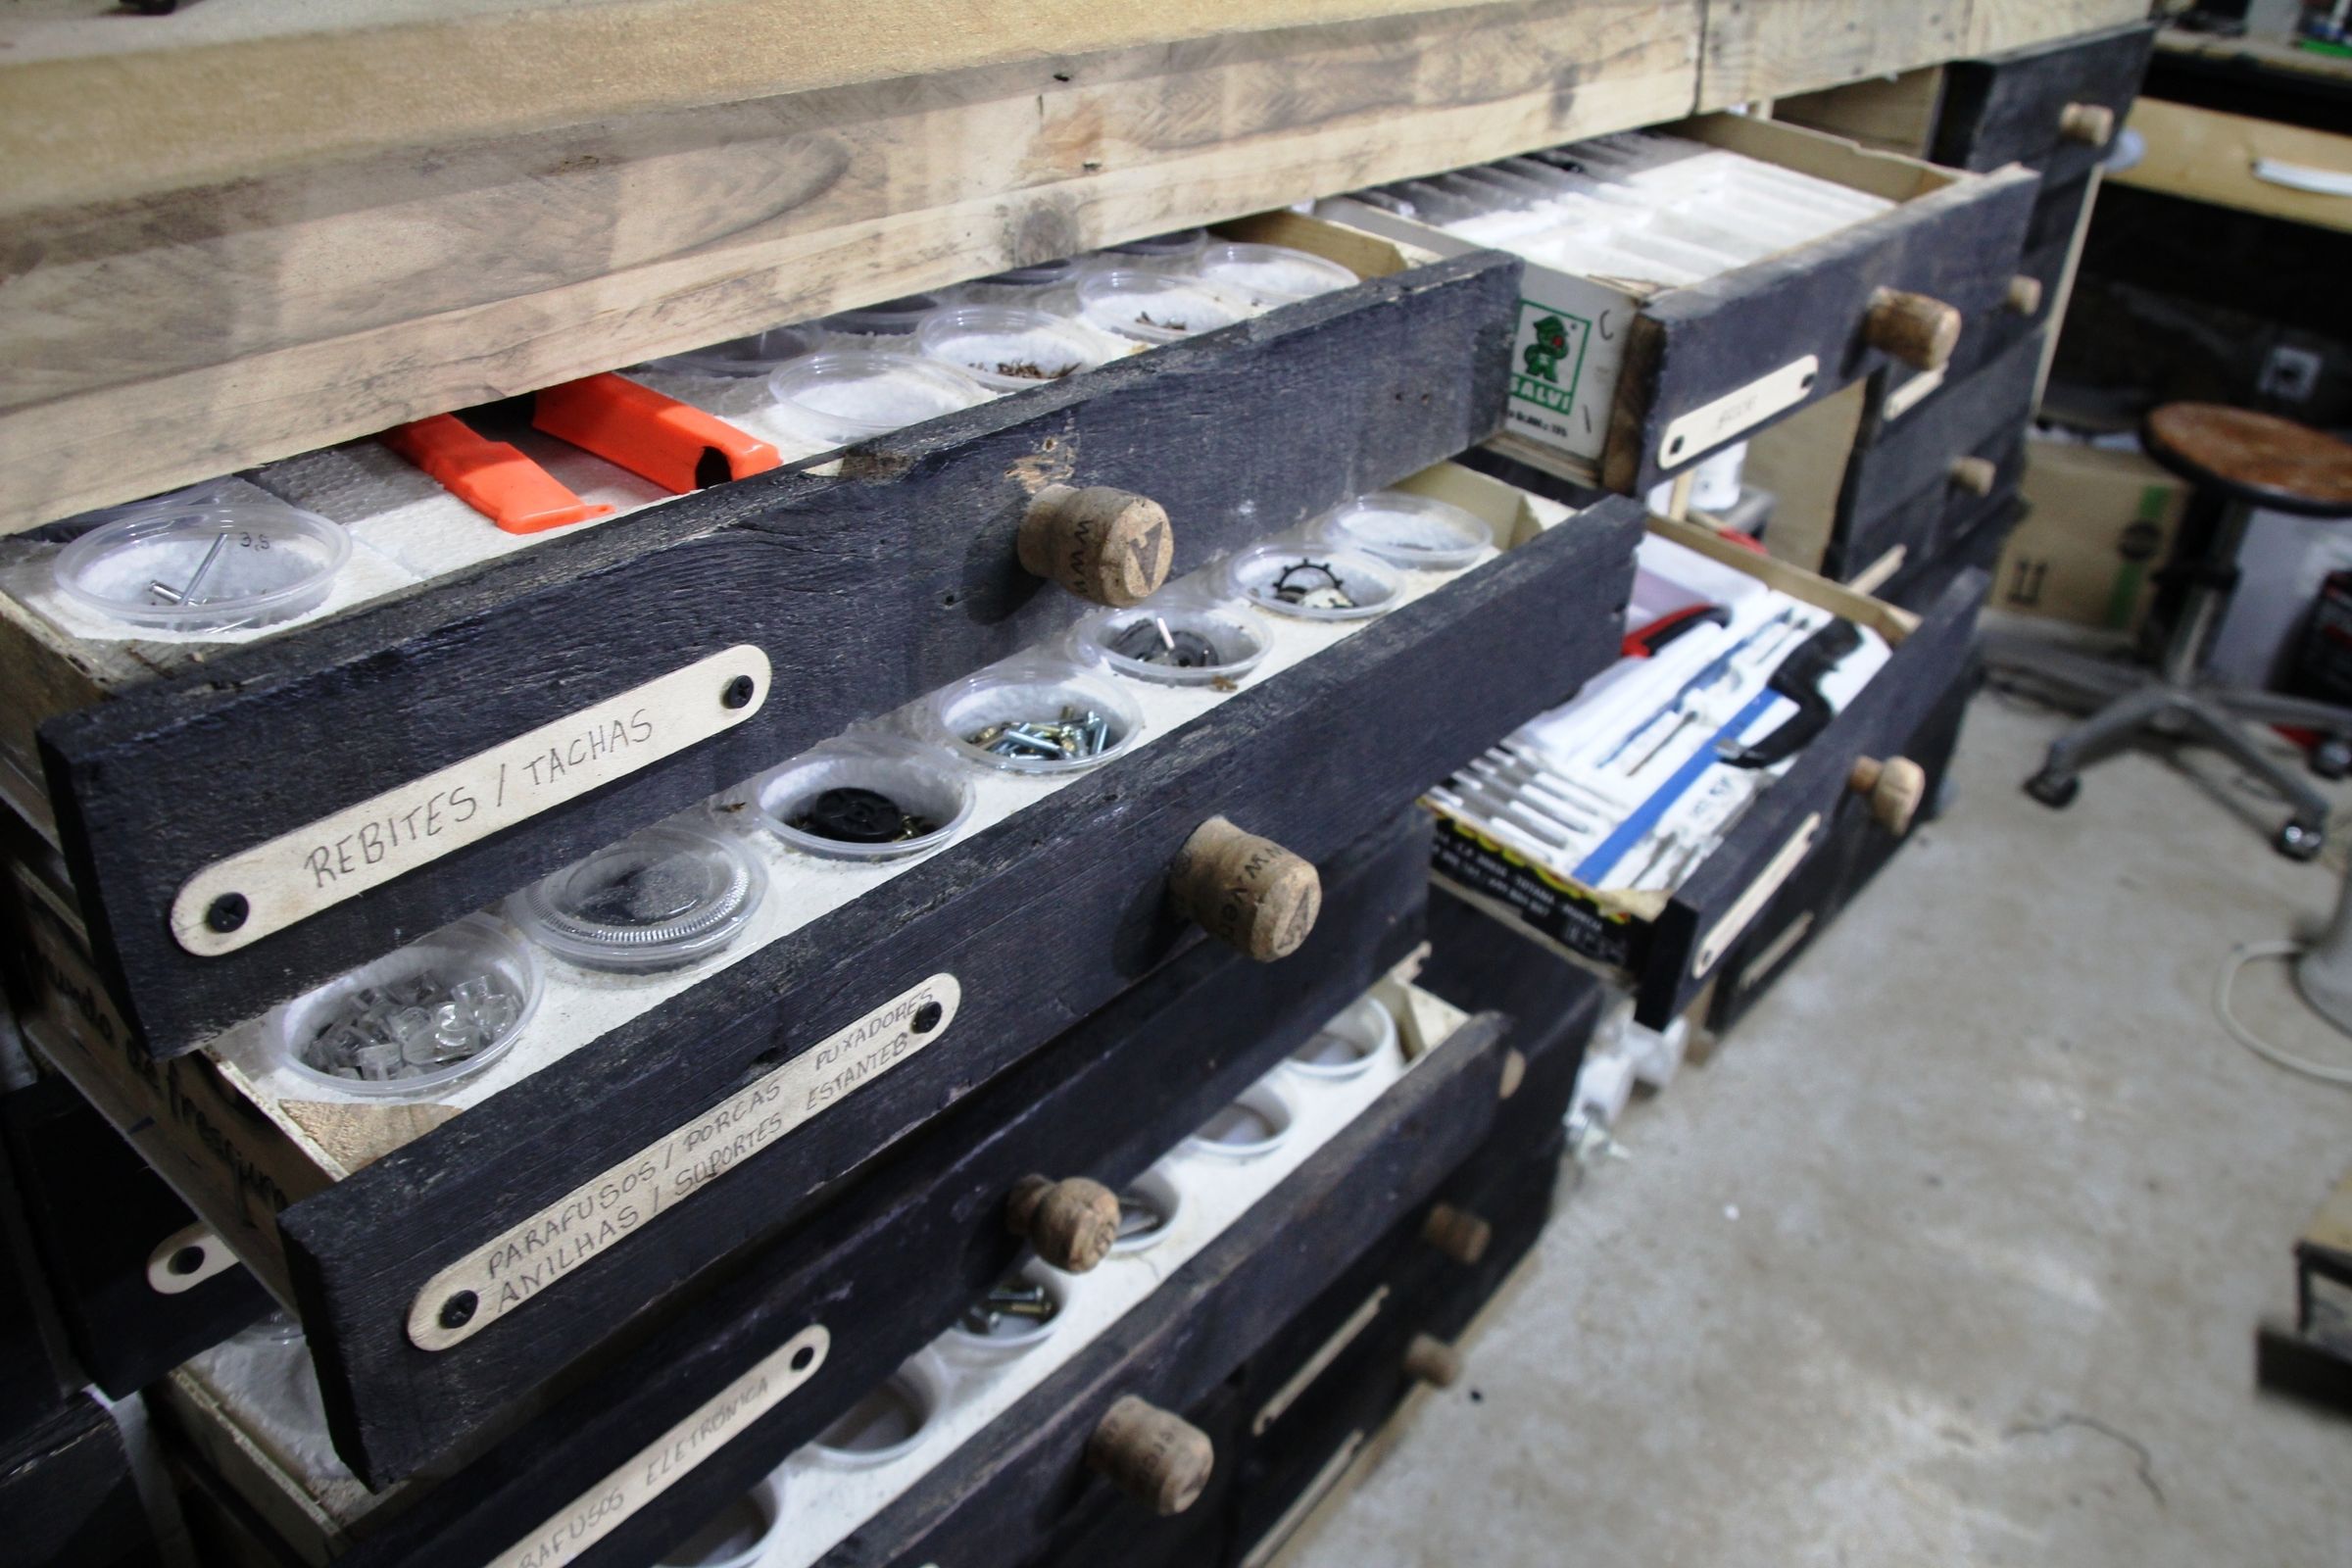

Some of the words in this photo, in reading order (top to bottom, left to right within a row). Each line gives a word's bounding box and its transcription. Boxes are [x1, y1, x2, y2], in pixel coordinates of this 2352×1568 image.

[303, 786, 477, 888] REBITES
[522, 709, 654, 786] TACHAS
[487, 1160, 657, 1280] PARAFUSOS
[682, 1078, 781, 1152] PORCAS
[815, 987, 934, 1071] PUXADORES
[498, 1204, 639, 1313] ANILHAS
[674, 1111, 782, 1197] SUPORTES
